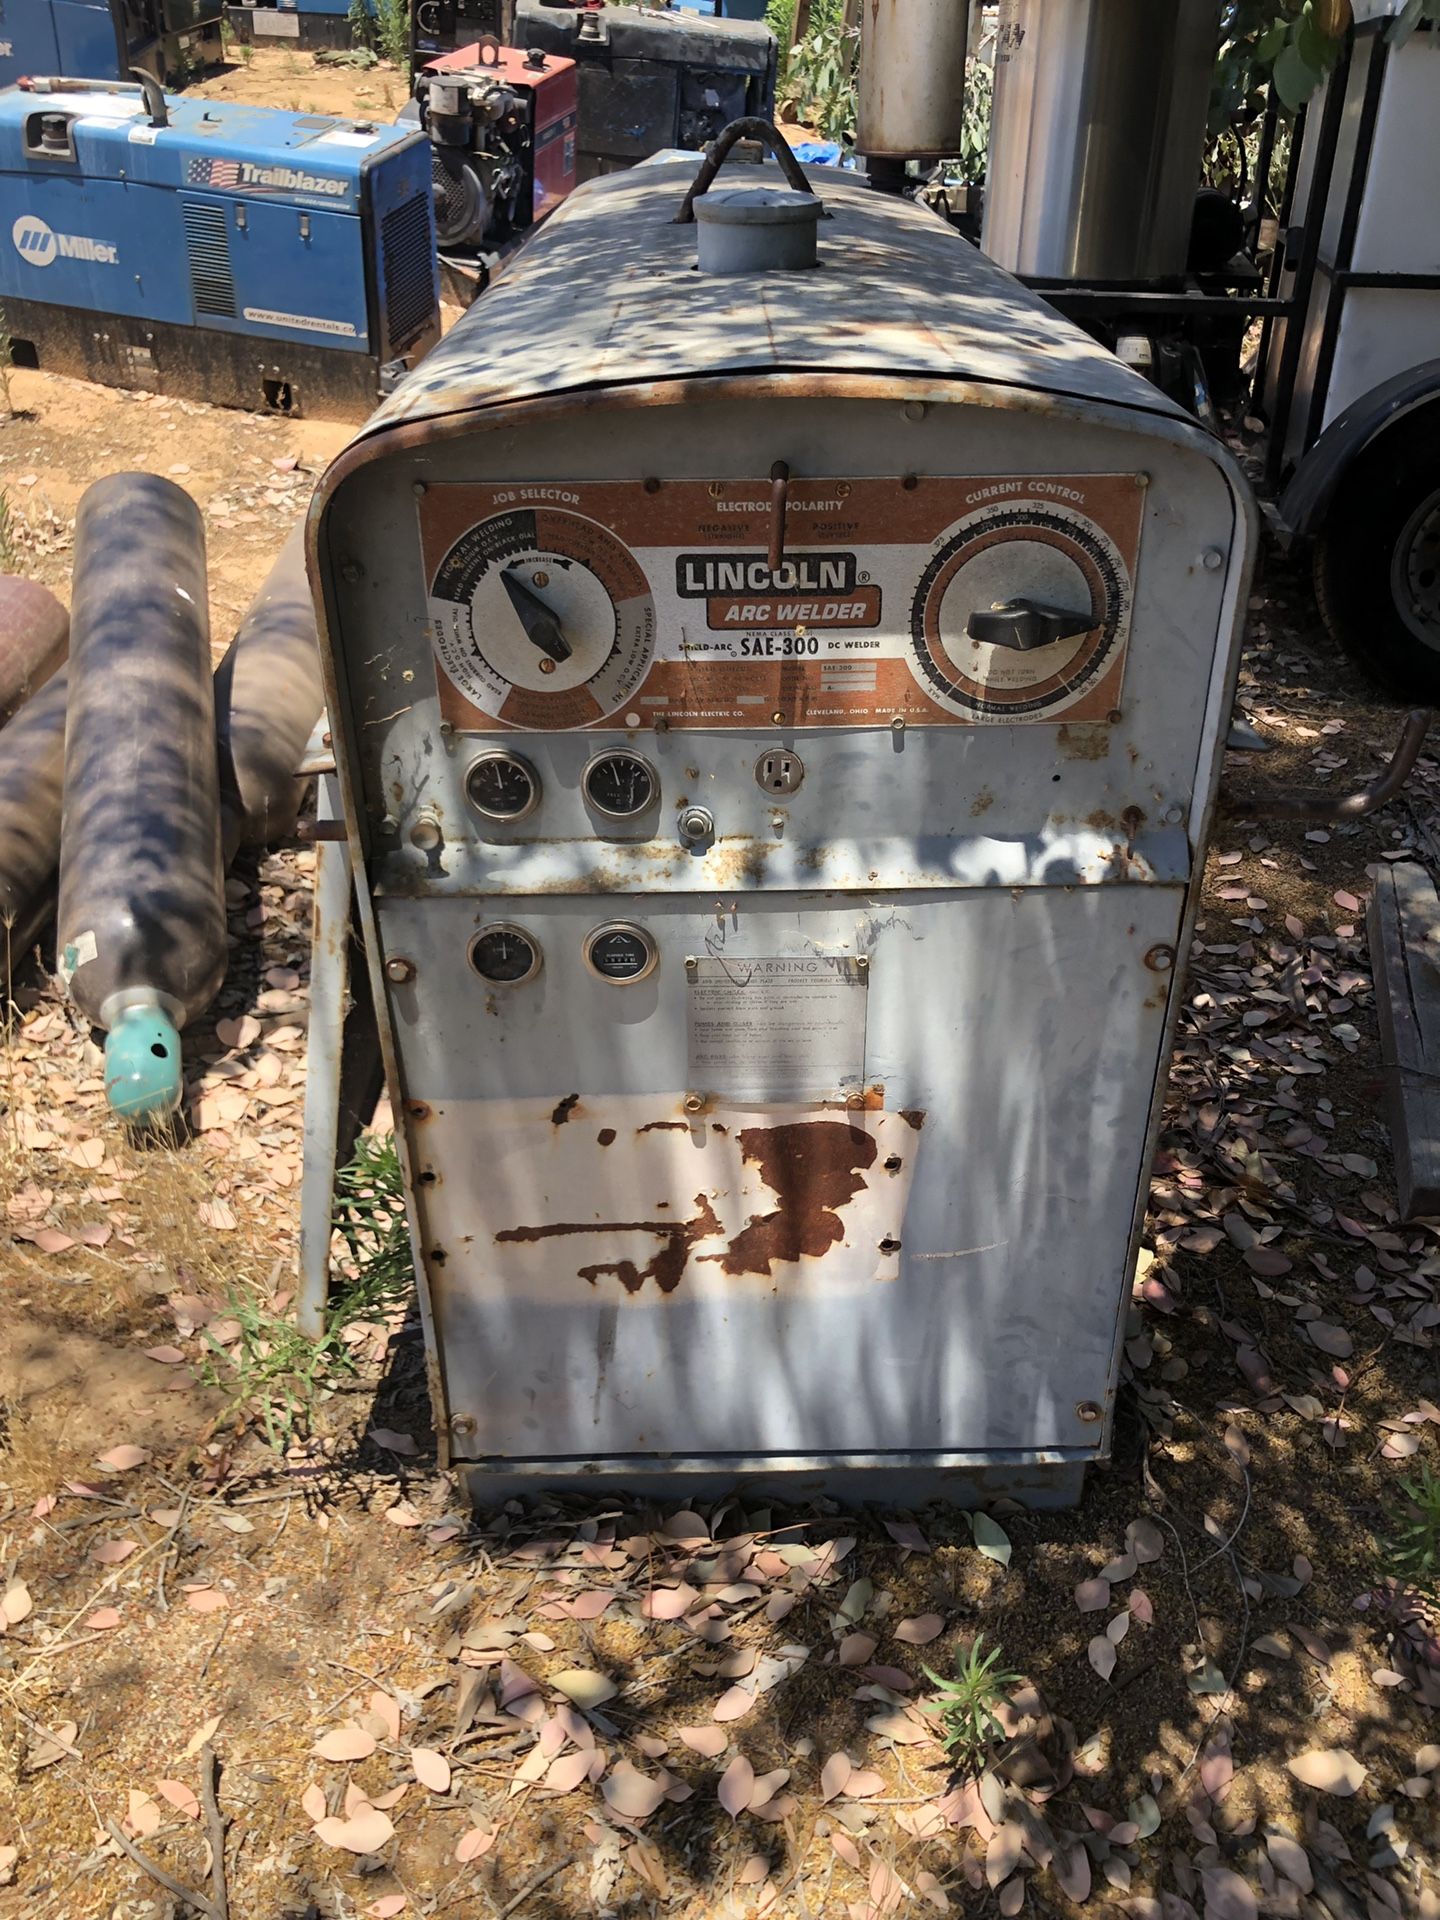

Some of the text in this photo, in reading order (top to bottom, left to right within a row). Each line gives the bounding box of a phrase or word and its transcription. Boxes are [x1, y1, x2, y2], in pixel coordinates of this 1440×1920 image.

[242, 163, 349, 196] Trailblazer
[59, 234, 118, 264] Miller
[492, 489, 580, 505] JOB SELECTOR
[965, 481, 1086, 504] CURRENT CONTROL
[716, 500, 844, 512] ELECTROD POLARITY
[518, 531, 535, 541] DIAL
[443, 518, 513, 579] NOAL WELDING
[685, 560, 846, 591] LINCOLN
[724, 603, 867, 621] ARC WELDER
[453, 623, 461, 644] WHIT
[612, 607, 653, 703] SPECIAL APPLICATINS
[678, 636, 880, 656] SHIELD-ARC SAE-300 DC WELDER
[434, 620, 482, 699] LARGE ELECTRODES
[971, 712, 1043, 724] LARGE ELECTRODES
[737, 962, 818, 973] WARNING
